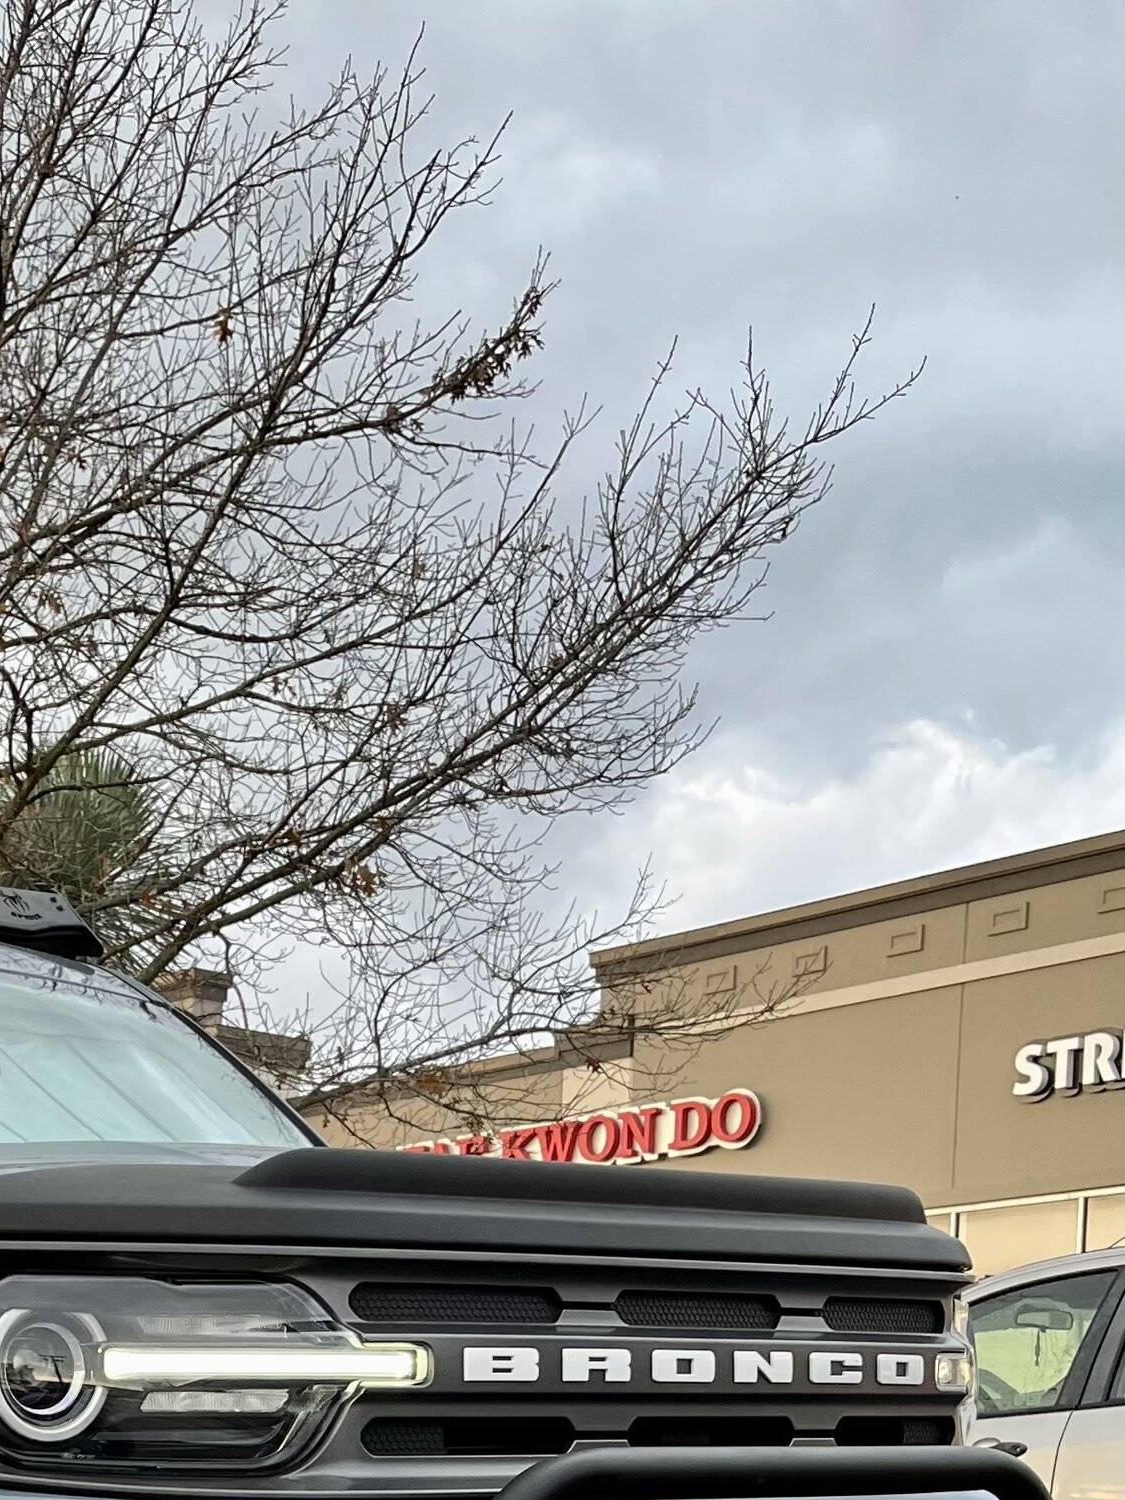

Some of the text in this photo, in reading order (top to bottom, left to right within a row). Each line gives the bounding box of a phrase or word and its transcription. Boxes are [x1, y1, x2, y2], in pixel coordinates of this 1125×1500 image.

[1012, 1030, 1125, 1096] STR
[498, 1092, 757, 1163] KWON DO
[462, 1346, 924, 1386] BRONCO
